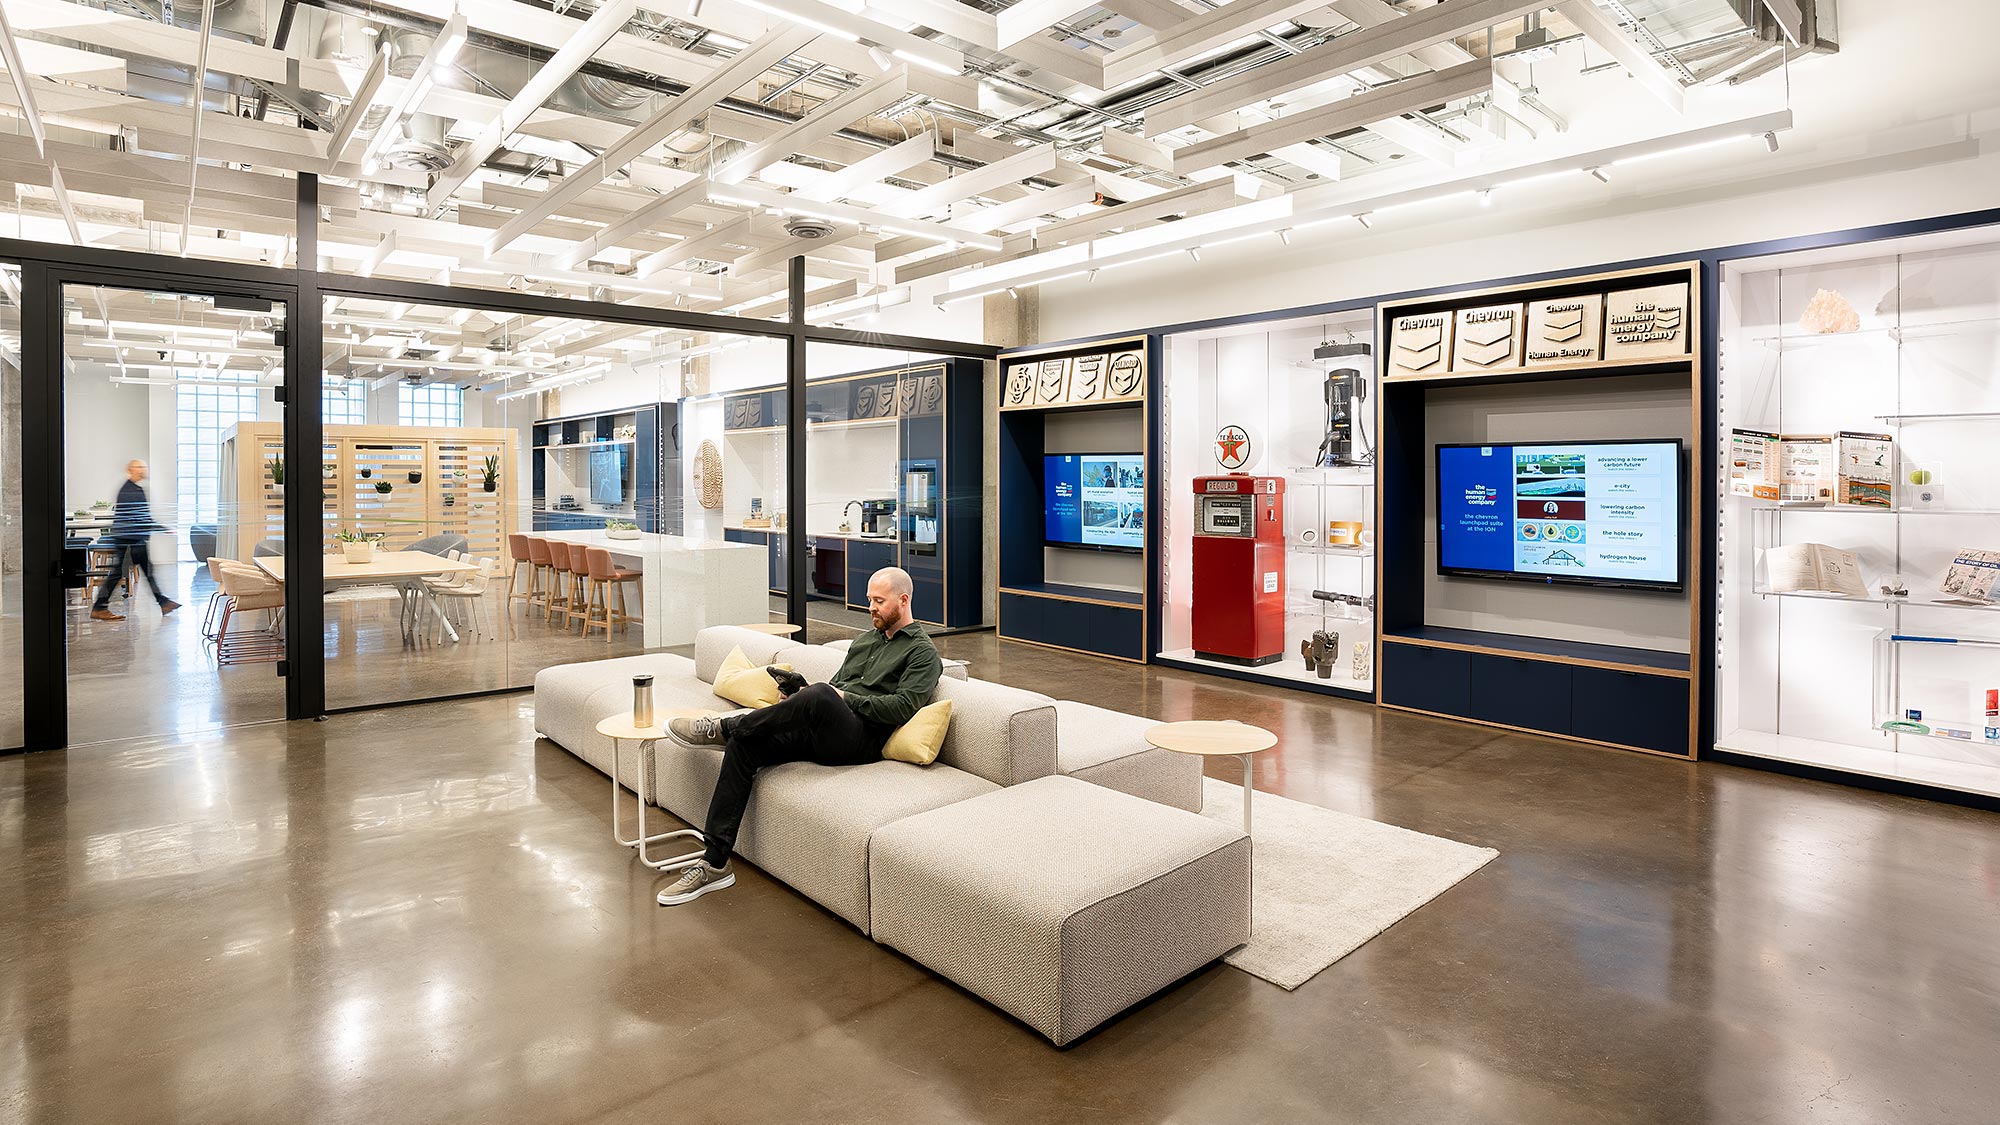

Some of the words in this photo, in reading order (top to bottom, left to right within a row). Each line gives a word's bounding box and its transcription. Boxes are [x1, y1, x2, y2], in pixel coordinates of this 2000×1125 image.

[1546, 303, 1583, 313] Chevron
[1634, 302, 1655, 312] the
[1465, 309, 1513, 323] Chevron
[1610, 314, 1655, 324] human
[1398, 317, 1443, 331] Chevron
[1609, 322, 1655, 334] energy
[1616, 330, 1676, 343] company
[1528, 351, 1559, 360] Human
[1209, 481, 1236, 490] REGULAR
